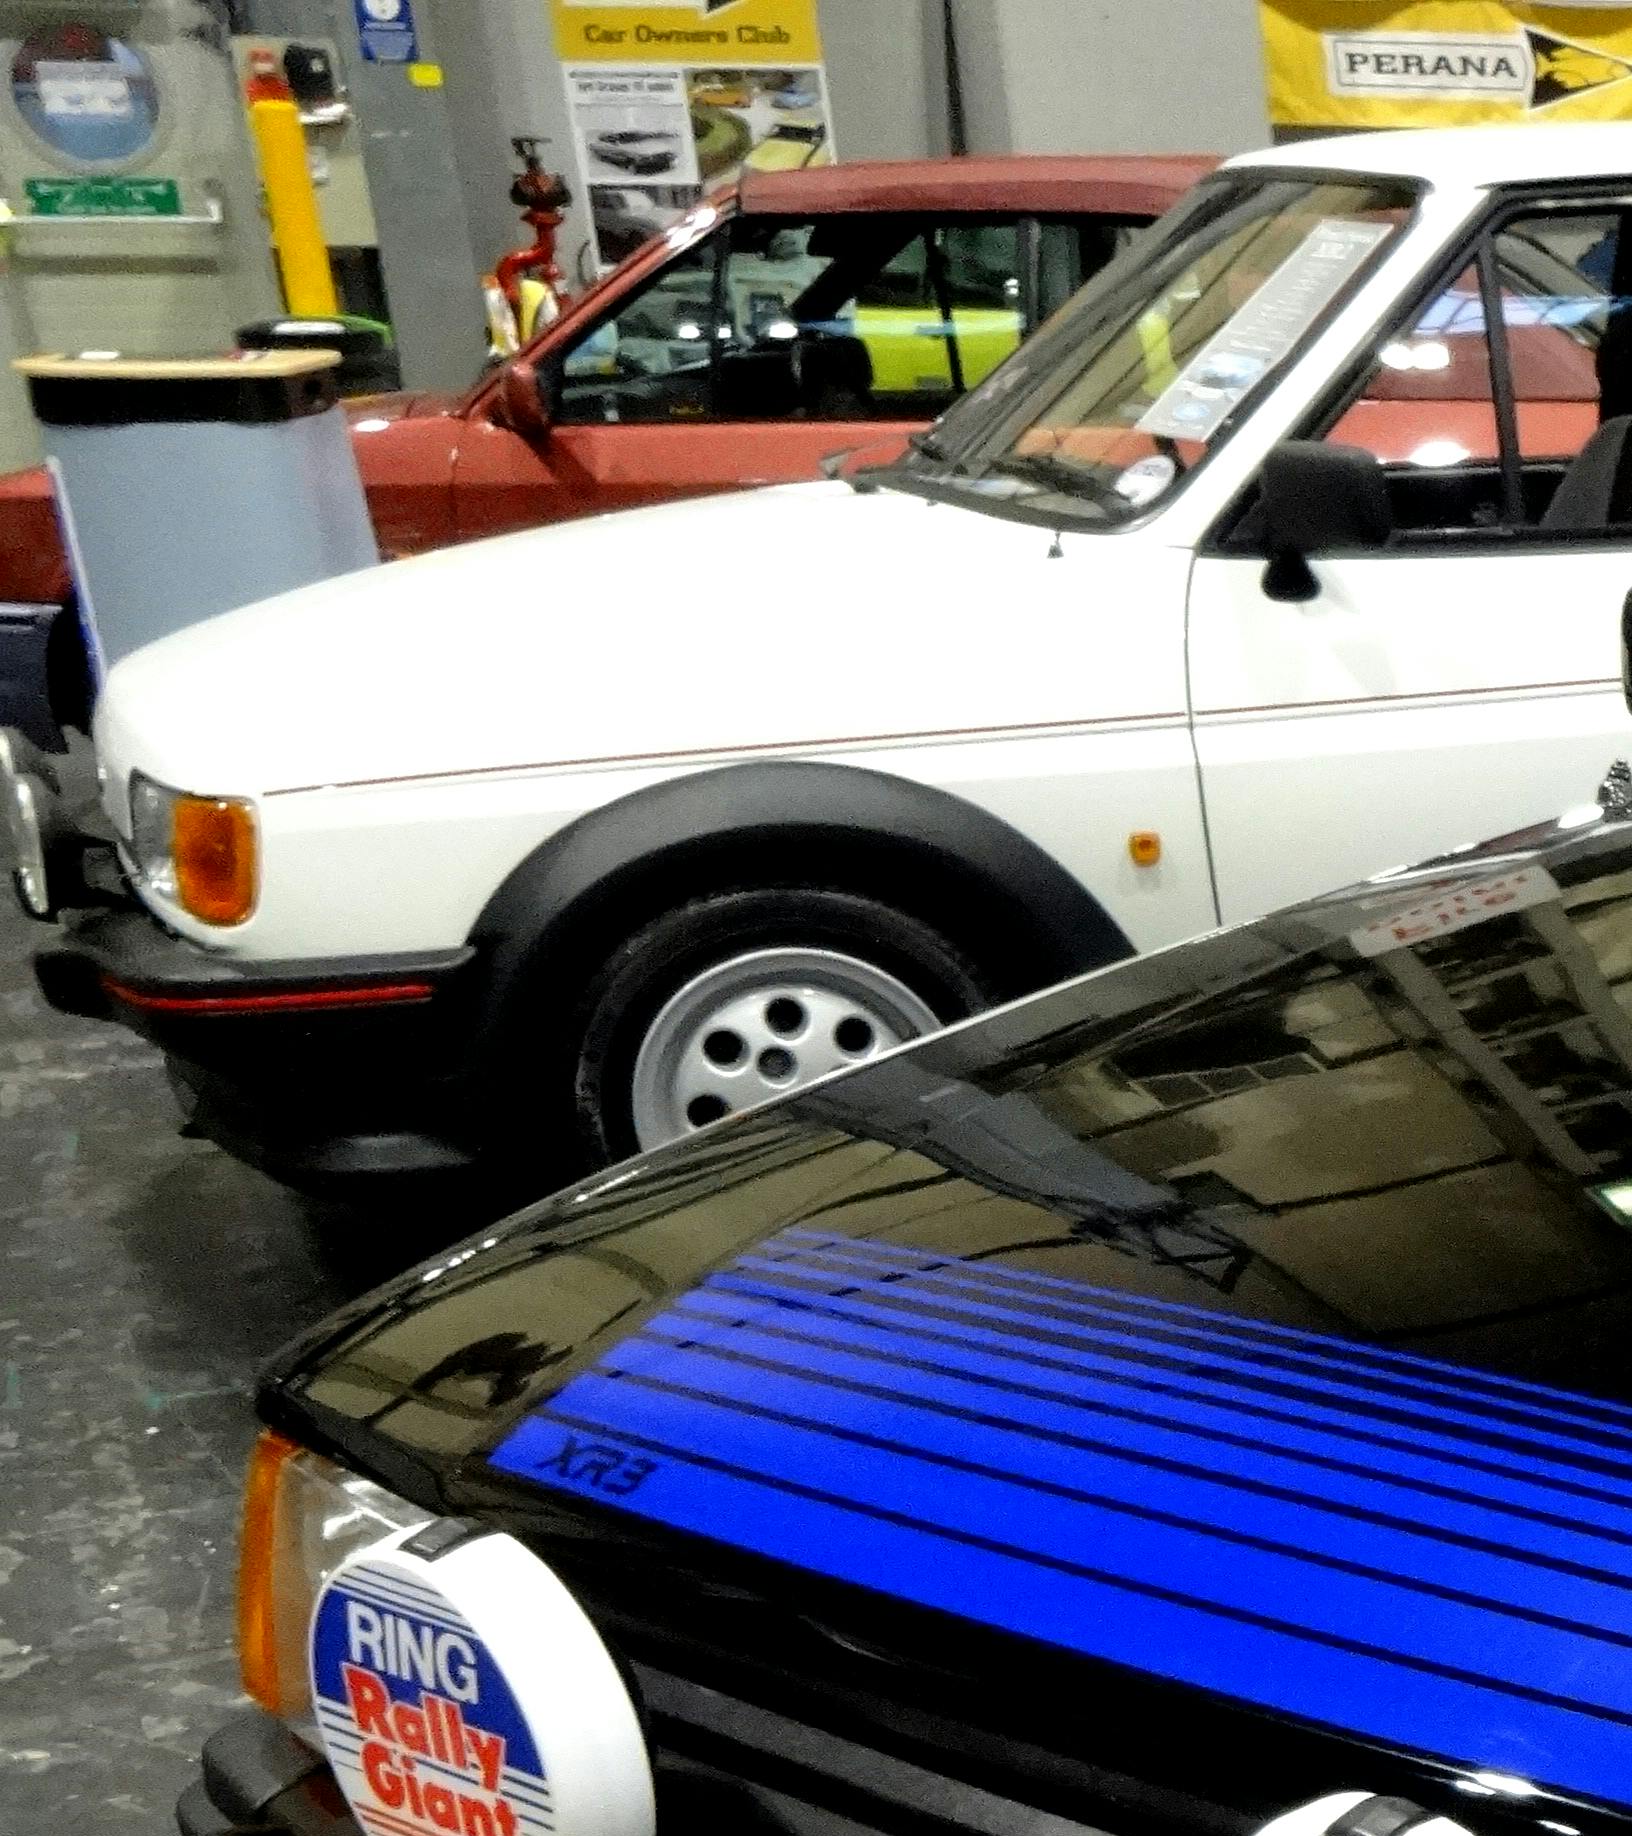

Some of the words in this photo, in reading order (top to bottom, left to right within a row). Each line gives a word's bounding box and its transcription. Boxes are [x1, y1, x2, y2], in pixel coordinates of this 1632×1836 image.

[583, 24, 625, 43] Car
[635, 24, 728, 44] Owners
[737, 25, 791, 44] Club
[1345, 52, 1517, 78] PERANA
[533, 1436, 657, 1495] XR3
[345, 1601, 478, 1704] RING
[342, 1663, 506, 1793] Rally
